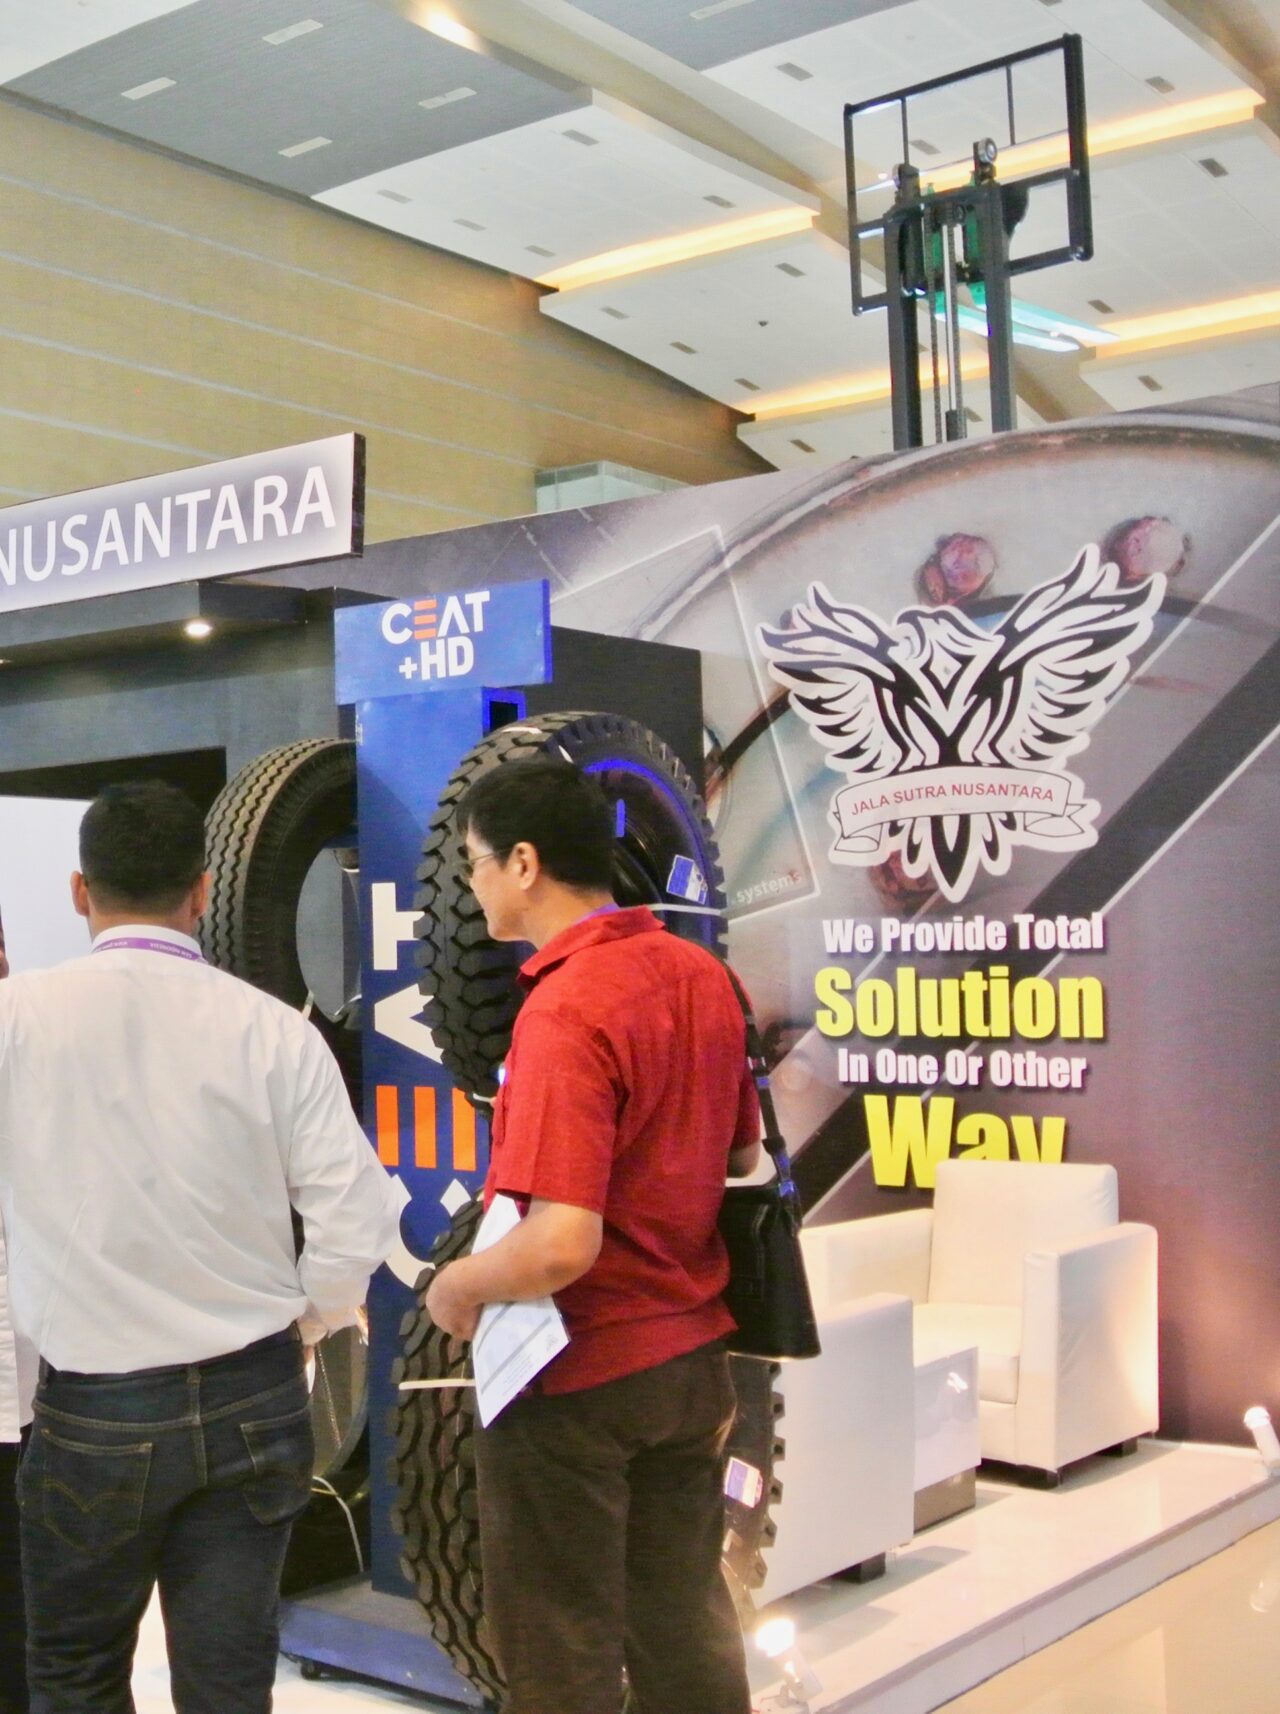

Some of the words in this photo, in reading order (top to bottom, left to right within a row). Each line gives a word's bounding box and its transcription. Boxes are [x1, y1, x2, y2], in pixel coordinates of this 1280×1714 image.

[381, 590, 490, 645] CEAT
[851, 794, 890, 816] JALA
[893, 784, 947, 804] SUTRA
[951, 783, 1054, 802] NUSANTARA
[822, 919, 873, 953] We
[881, 915, 1007, 952] Provide
[1013, 912, 1104, 950] Total
[814, 965, 1104, 1038] Solution
[837, 1048, 869, 1083] In
[875, 1048, 938, 1084] One
[945, 1049, 983, 1085] Or
[990, 1050, 1087, 1088] Other
